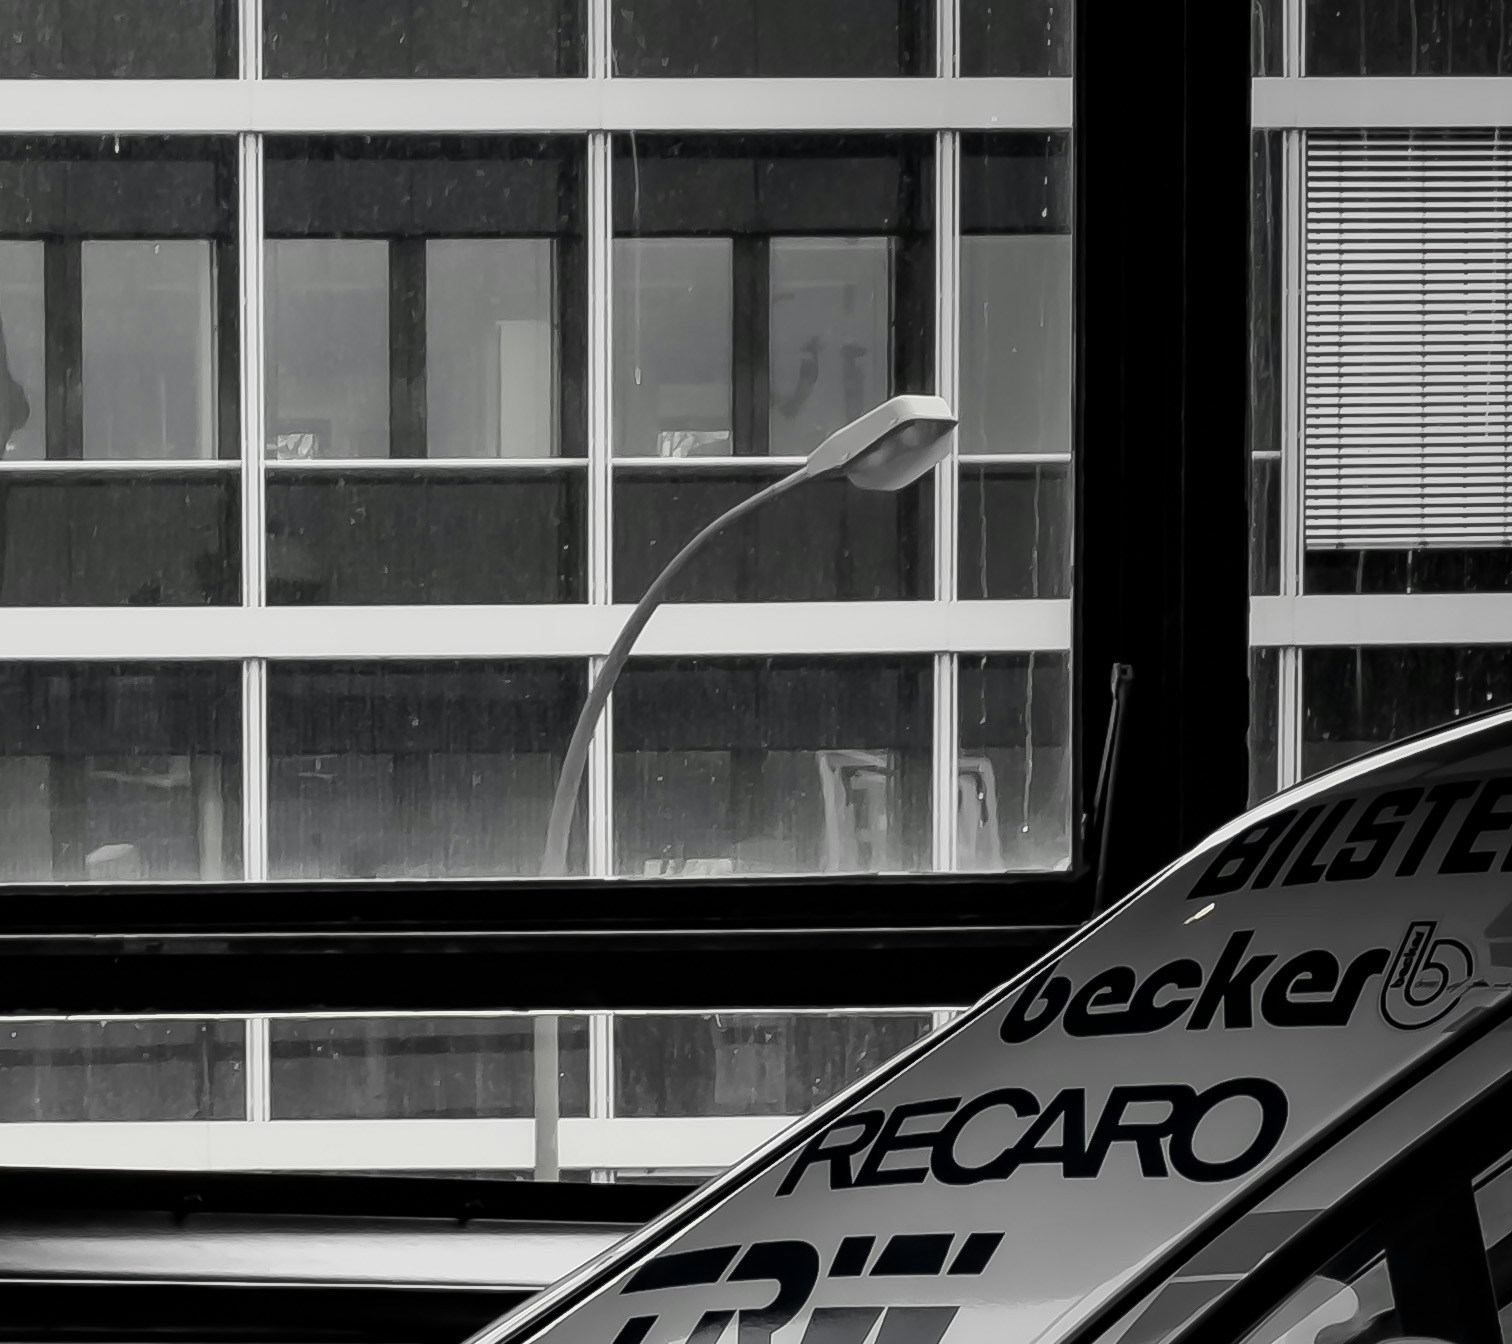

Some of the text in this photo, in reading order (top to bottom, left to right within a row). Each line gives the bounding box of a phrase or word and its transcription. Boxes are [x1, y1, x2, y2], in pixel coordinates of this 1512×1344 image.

[1188, 776, 1512, 898] BILSTE
[999, 929, 1391, 1043] becker
[776, 1078, 1288, 1196] RECARO
